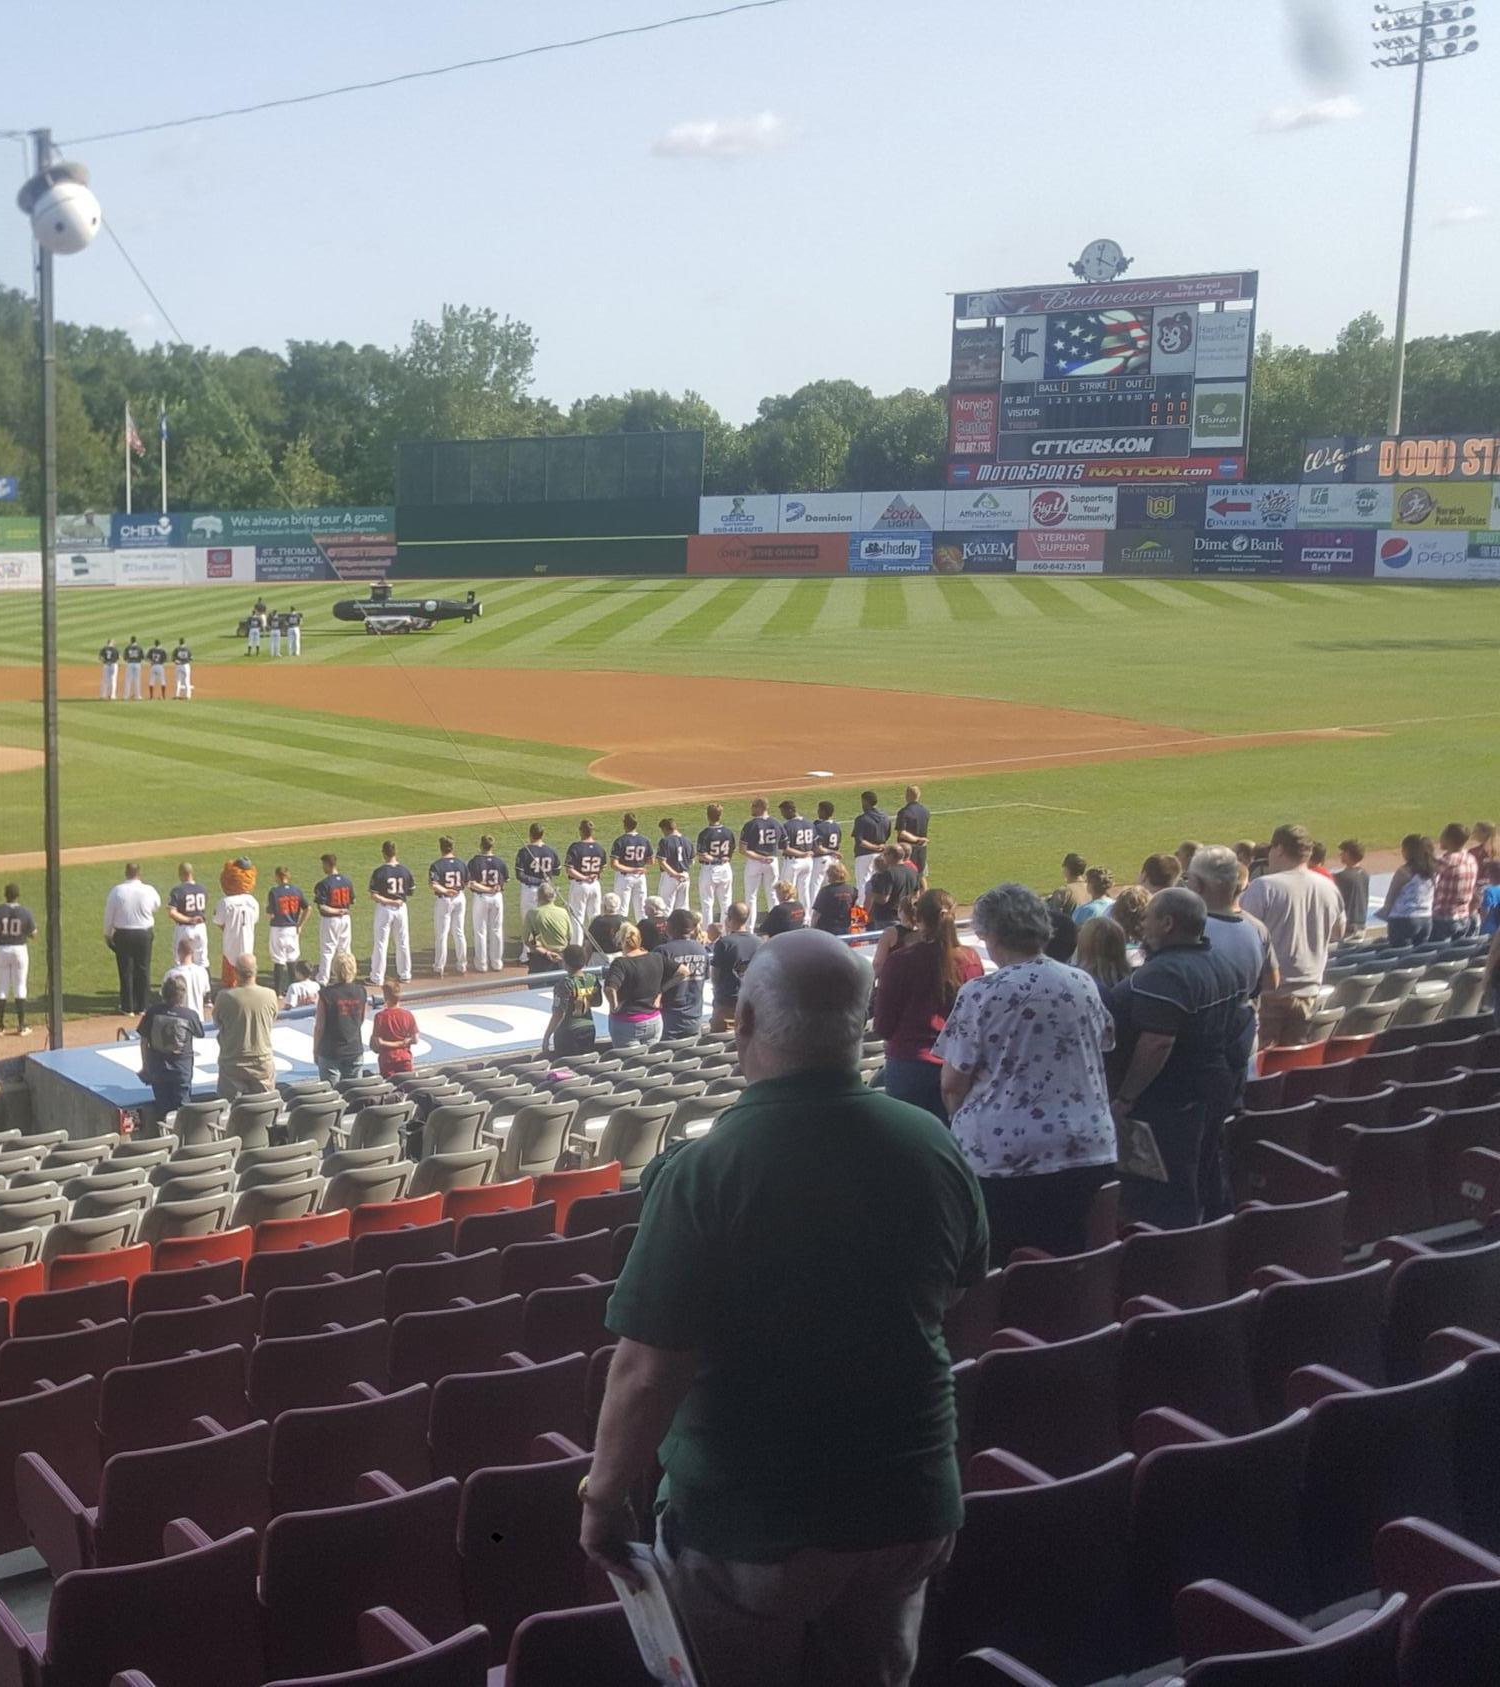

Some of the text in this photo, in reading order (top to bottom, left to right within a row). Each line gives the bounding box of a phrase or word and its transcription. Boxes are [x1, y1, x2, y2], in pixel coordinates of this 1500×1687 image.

[1041, 289, 1161, 310] Budweiser
[1039, 384, 1059, 392] BALL
[1079, 382, 1108, 390] STRIKE
[1126, 380, 1143, 388] OUT
[957, 398, 993, 412] Norwich
[1004, 396, 1014, 404] AT
[1016, 396, 1031, 404] BAT
[1007, 409, 1040, 417] VISITOR
[1303, 444, 1373, 473] Welcome
[1378, 440, 1456, 477] DODD
[1334, 462, 1347, 474] to
[1070, 494, 1113, 503] Supporting
[1211, 487, 1255, 496] 3RD BASE
[1083, 505, 1100, 513] Your
[231, 516, 250, 526] We
[252, 515, 289, 528] always
[321, 515, 340, 525] our
[343, 513, 353, 524] A
[355, 514, 388, 527] game.
[720, 514, 755, 522] GEICO
[805, 513, 852, 522] Dominion
[888, 520, 914, 528] LIGHT
[1067, 513, 1114, 523] Community!
[1037, 533, 1085, 541] STERLING
[1194, 537, 1284, 551] Dime Bank
[278, 548, 317, 557] THOMAS
[963, 542, 1015, 560] KAYEM
[1040, 543, 1090, 552] SUPERIOR
[285, 556, 324, 566] SCHOOL
[1303, 551, 1334, 560] ROXY
[1417, 549, 1468, 566] pepsi
[758, 829, 776, 844] 12
[796, 829, 813, 844] 28
[828, 833, 837, 849] 9
[624, 845, 646, 861] 50
[677, 845, 683, 861] 1
[710, 840, 730, 856] 54
[530, 857, 552, 872] 40
[581, 856, 600, 872] 52
[445, 871, 461, 887] 51
[481, 869, 499, 885] 13
[386, 877, 404, 894] 31
[185, 893, 206, 912] 20
[1, 917, 22, 935] 10
